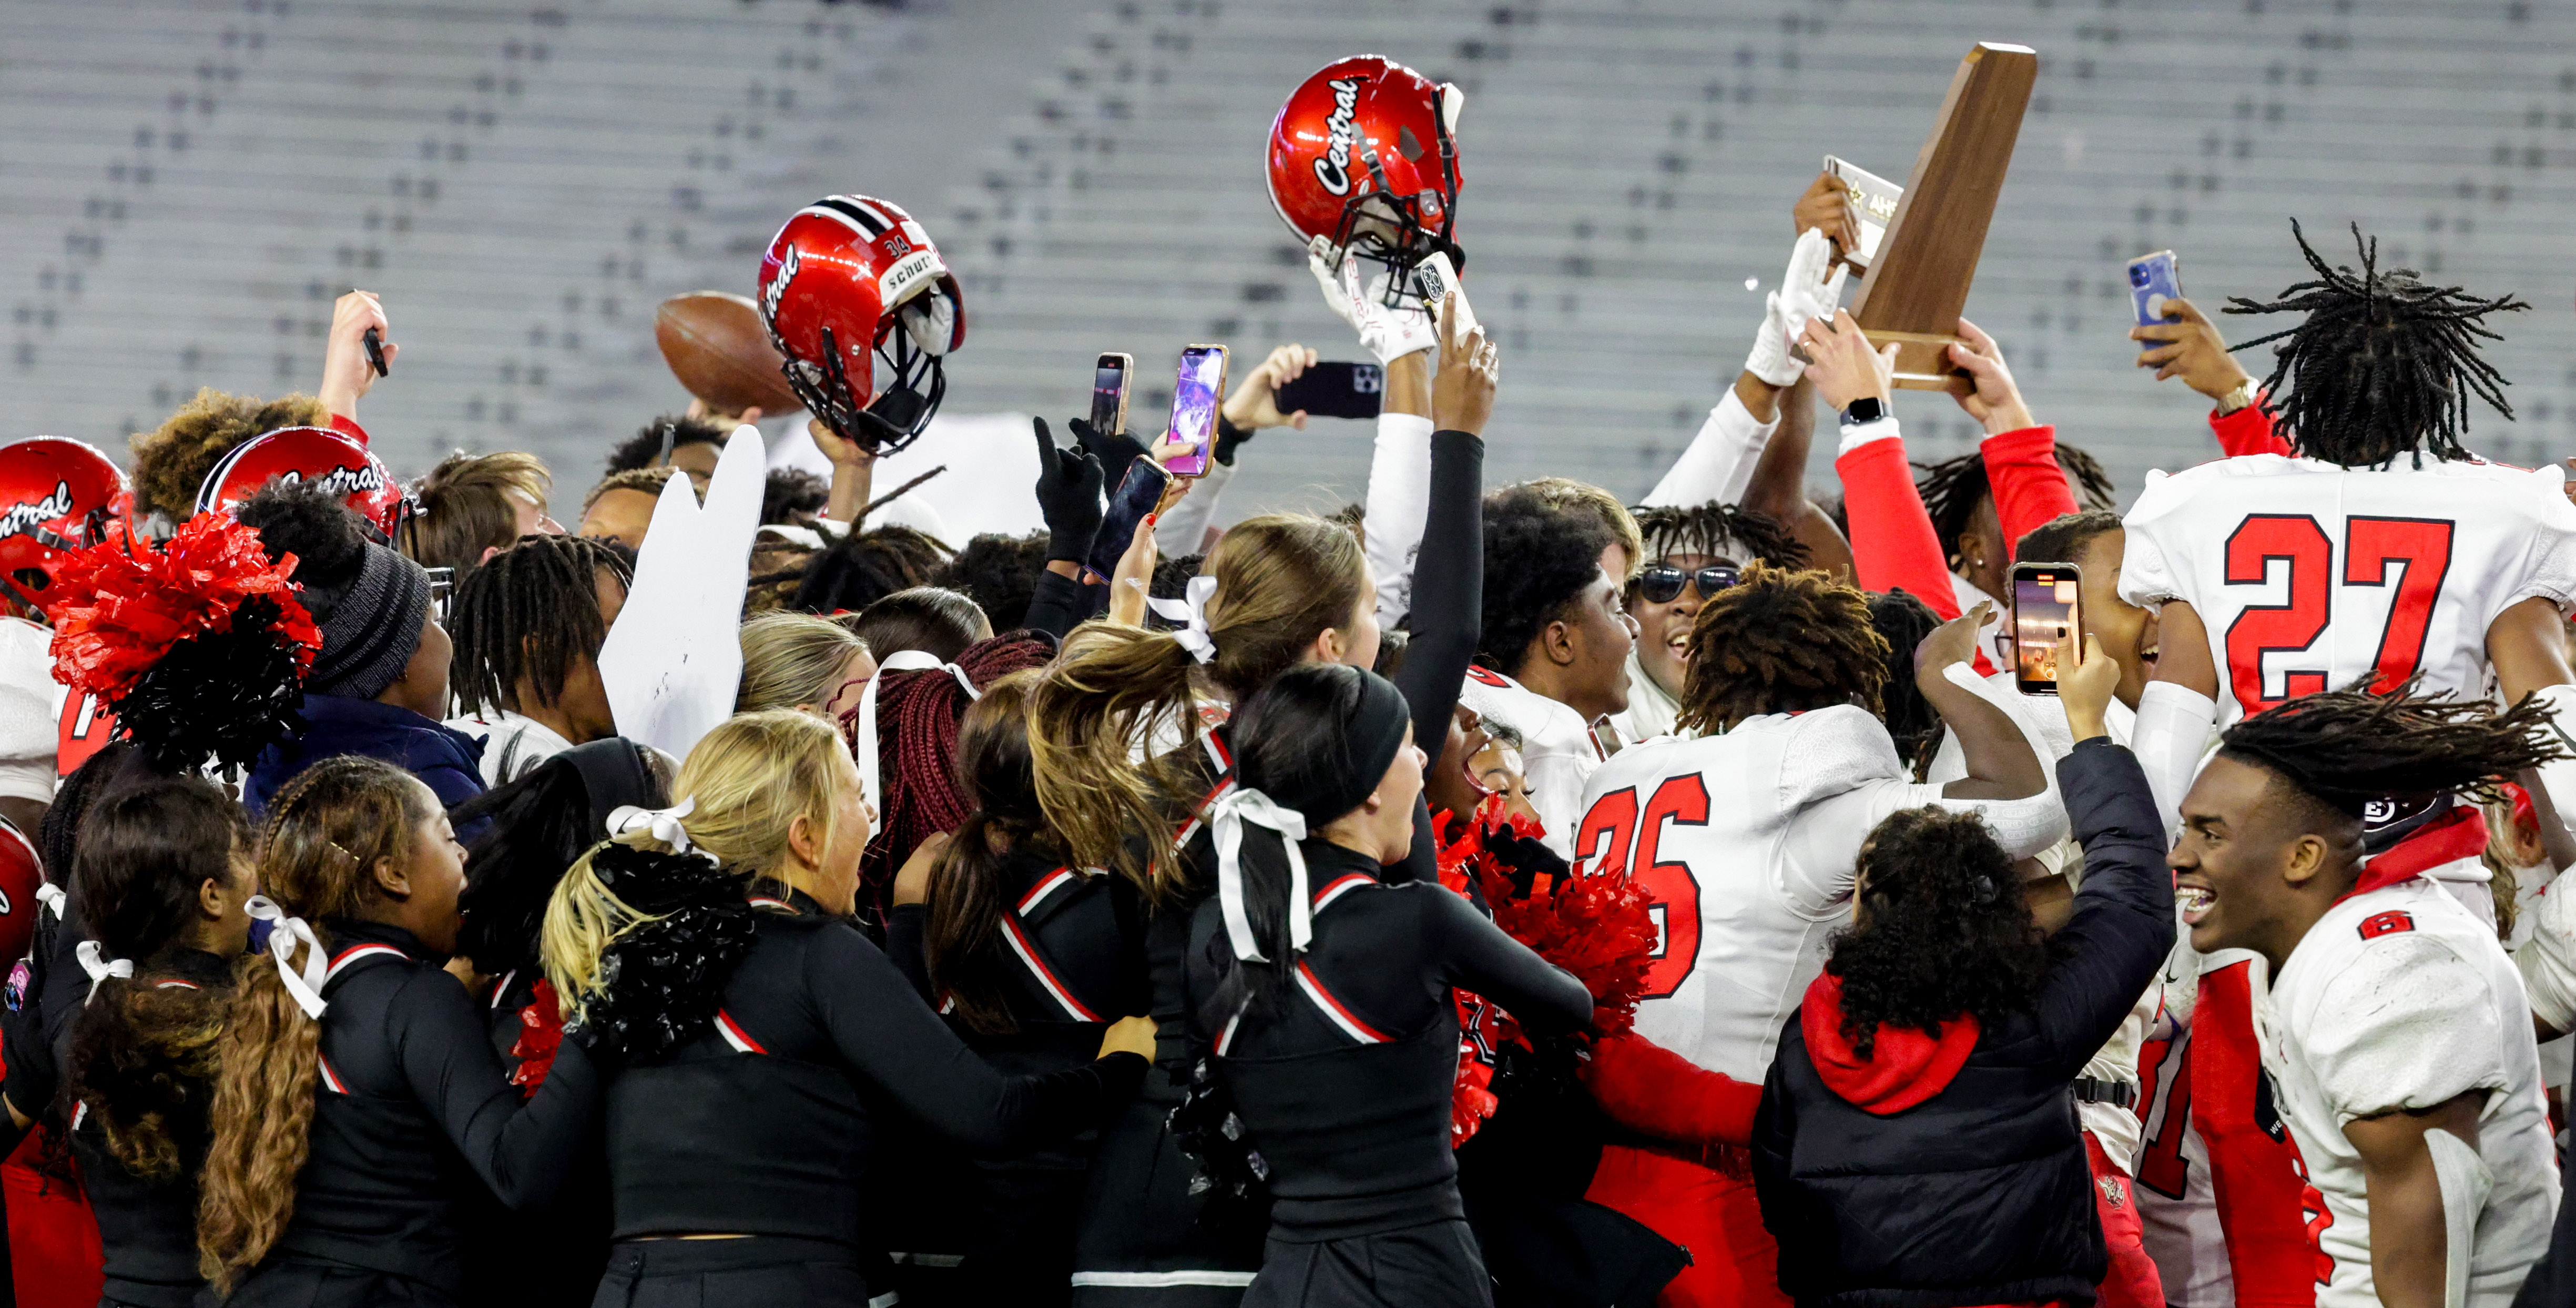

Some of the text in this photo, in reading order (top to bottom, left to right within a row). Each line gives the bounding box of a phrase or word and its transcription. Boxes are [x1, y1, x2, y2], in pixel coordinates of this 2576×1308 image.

[1314, 79, 1359, 196] Central
[884, 235, 911, 260] 34
[2224, 513, 2456, 722] 27
[2357, 910, 2416, 941] 6
